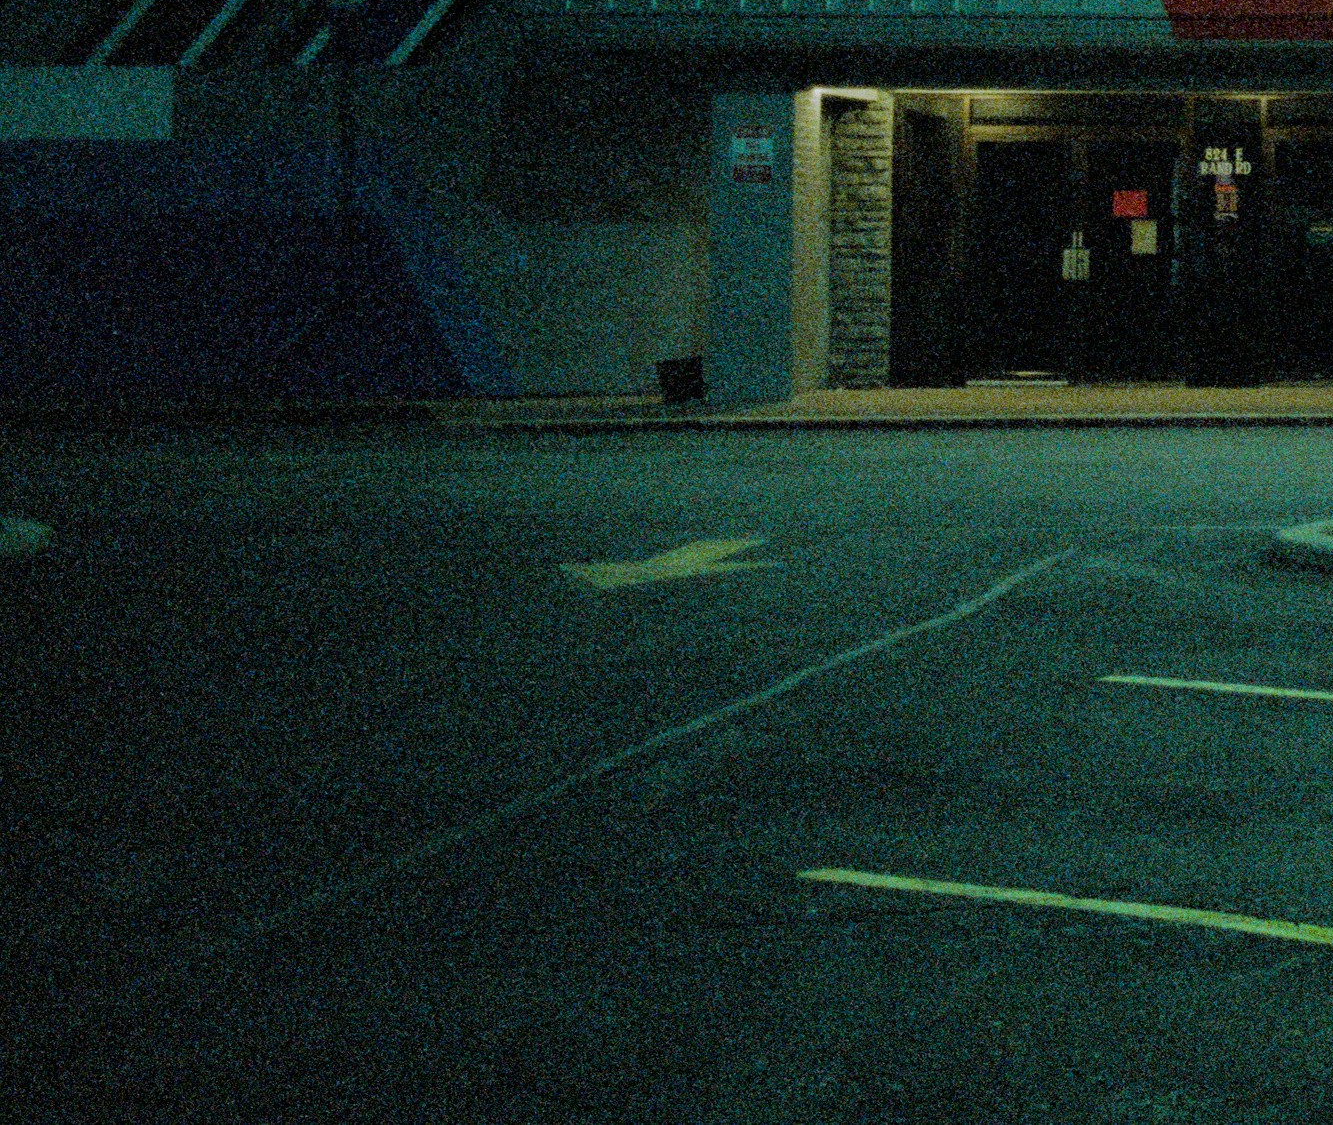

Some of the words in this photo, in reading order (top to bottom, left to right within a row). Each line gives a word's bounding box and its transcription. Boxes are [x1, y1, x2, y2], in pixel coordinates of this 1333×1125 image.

[1205, 147, 1228, 161] 824
[1235, 147, 1244, 161] E
[1199, 161, 1233, 175] RAND
[1235, 161, 1252, 175] RD
